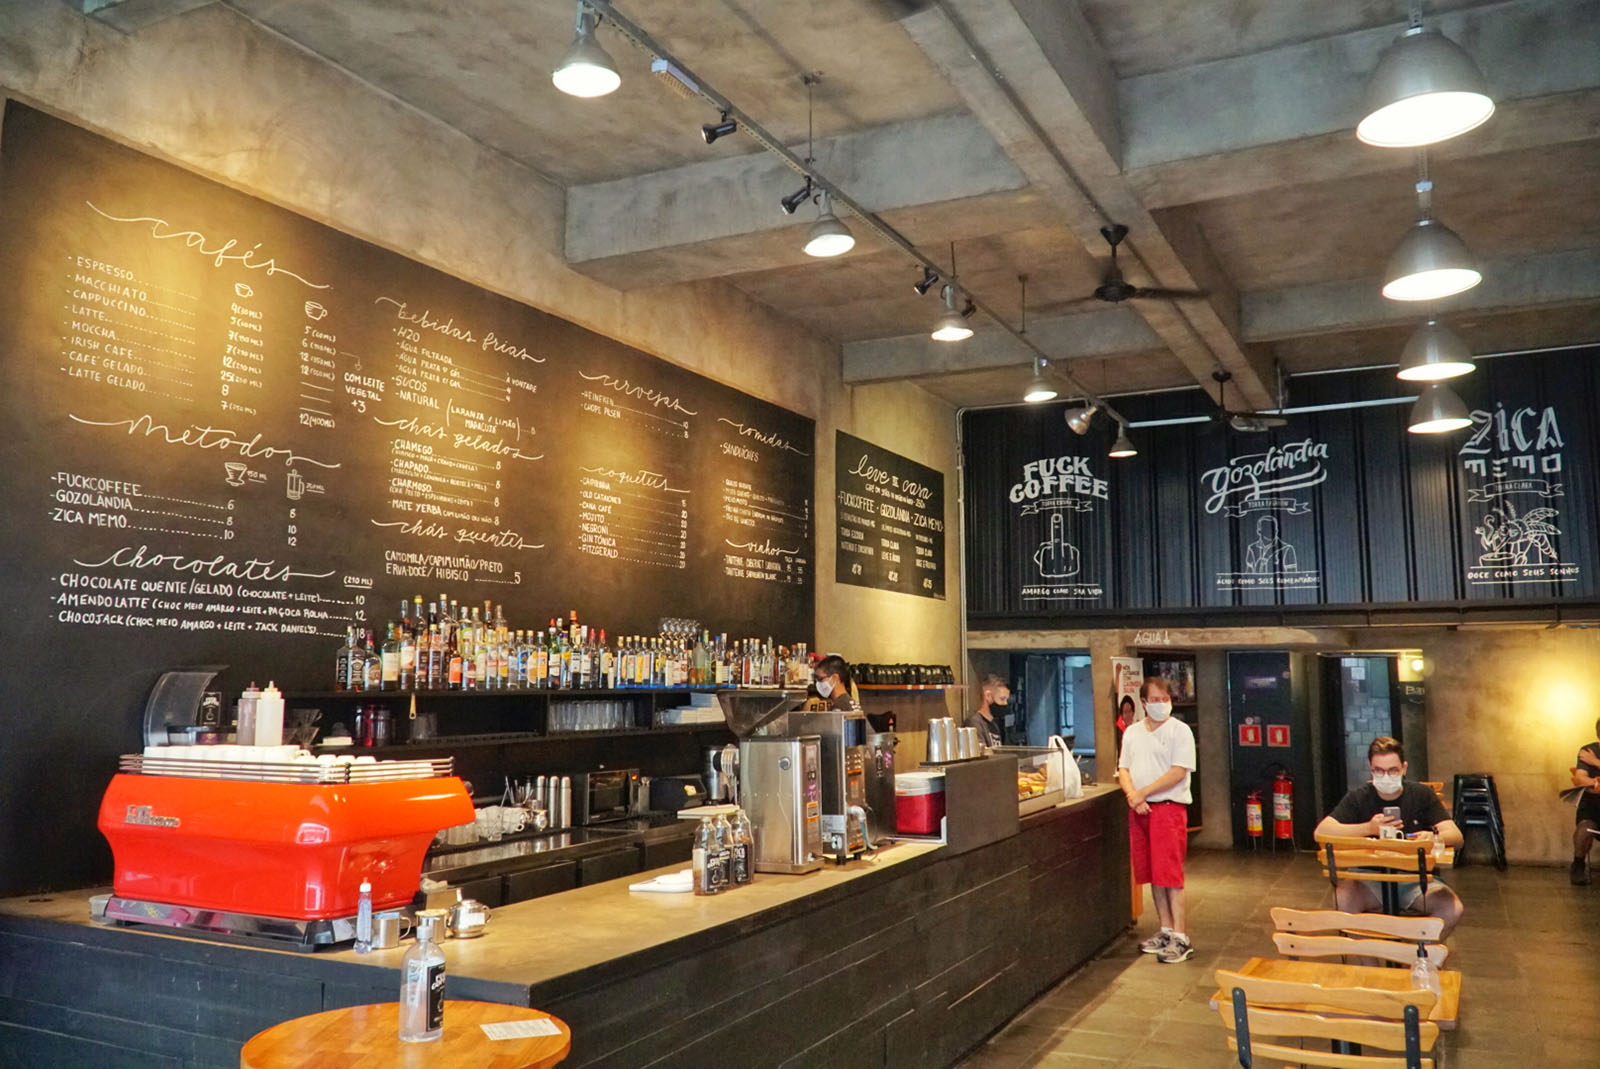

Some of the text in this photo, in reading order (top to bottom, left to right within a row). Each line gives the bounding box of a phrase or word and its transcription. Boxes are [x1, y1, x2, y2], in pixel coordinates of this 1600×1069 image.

[77, 256, 134, 281] ESPRESSO
[75, 273, 147, 301] MACCHIATO
[73, 289, 147, 317] CAPPUCCINO
[72, 304, 105, 321] LATTE
[71, 320, 116, 340] MOCCHA
[397, 326, 420, 342] H2O
[71, 336, 100, 350] IRISH
[103, 358, 144, 376] GELADO
[68, 366, 146, 392] LATTE GELADO
[344, 371, 385, 392] COM LEITE
[395, 375, 427, 393] SUCOS
[221, 384, 229, 396] 8
[345, 384, 382, 402] VEGETAL
[400, 389, 440, 410] NATURAL
[394, 439, 433, 455] CHAMEGO
[393, 458, 429, 473] CHAPADO
[848, 454, 889, 485] leve
[1023, 456, 1093, 482] FUCK
[57, 472, 142, 497] FUCKCOFFEE
[391, 478, 433, 493] CHARMOSO
[1009, 474, 1109, 503] COFFEE
[227, 499, 235, 510] 6
[392, 499, 413, 511] MATE
[416, 503, 442, 516] YERBA
[53, 508, 127, 529] ZICA MEMO
[226, 515, 233, 526] 8
[582, 512, 604, 523] MOJITO
[224, 529, 234, 540] 10
[288, 525, 297, 534] 10
[582, 522, 609, 535] NEGRONI
[288, 536, 297, 546] 12
[582, 544, 618, 558] FITZGERALD
[436, 567, 469, 581] HIBISCO
[514, 572, 521, 584] 5
[1467, 571, 1490, 580] DOCE
[1523, 568, 1545, 577] SEUS
[60, 573, 138, 591] CHOCOLATE
[141, 581, 187, 594] QUENTE
[355, 595, 365, 605] 10
[184, 602, 203, 611] MEIO
[205, 603, 235, 613] AMARGO
[242, 606, 262, 615] LEITE
[355, 610, 367, 621] 12
[58, 610, 124, 625] CHOCOJACK
[156, 617, 178, 627] MEIO
[180, 619, 215, 631] AMARGO
[224, 621, 246, 631] LEITE
[255, 621, 278, 632] JACK
[356, 628, 366, 639] 18
